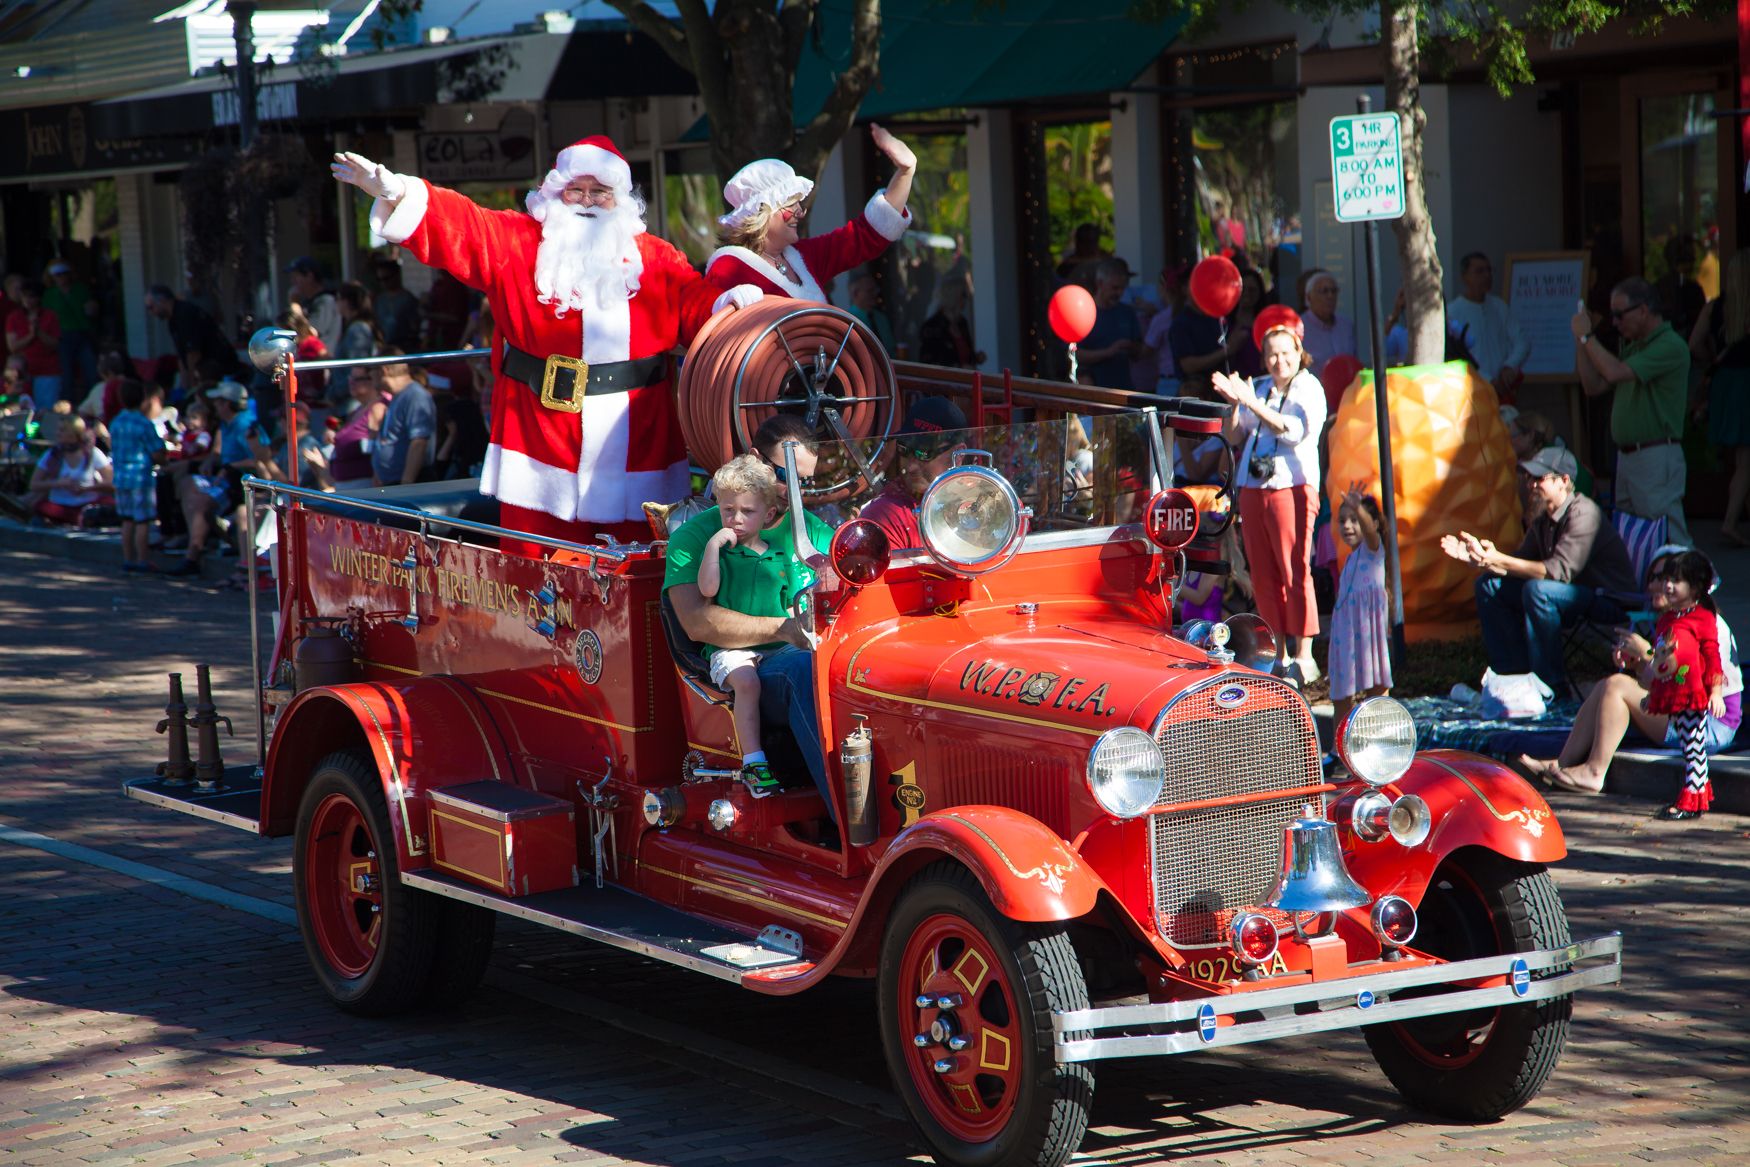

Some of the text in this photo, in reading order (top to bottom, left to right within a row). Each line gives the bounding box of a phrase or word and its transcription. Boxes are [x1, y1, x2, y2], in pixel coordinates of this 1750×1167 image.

[1362, 121, 1382, 135] HR
[1336, 127, 1351, 150] 3
[1355, 138, 1395, 150] PARKING
[1373, 156, 1395, 170] AM
[1359, 172, 1376, 185] TO
[1375, 183, 1396, 197] PM
[1154, 508, 1194, 532] FIRE
[329, 543, 390, 585] WINTER
[393, 563, 432, 595] PAK
[436, 568, 521, 616] FIREMEN'S
[960, 659, 1117, 717] W.P. F.A.
[1188, 957, 1243, 984] 1929
